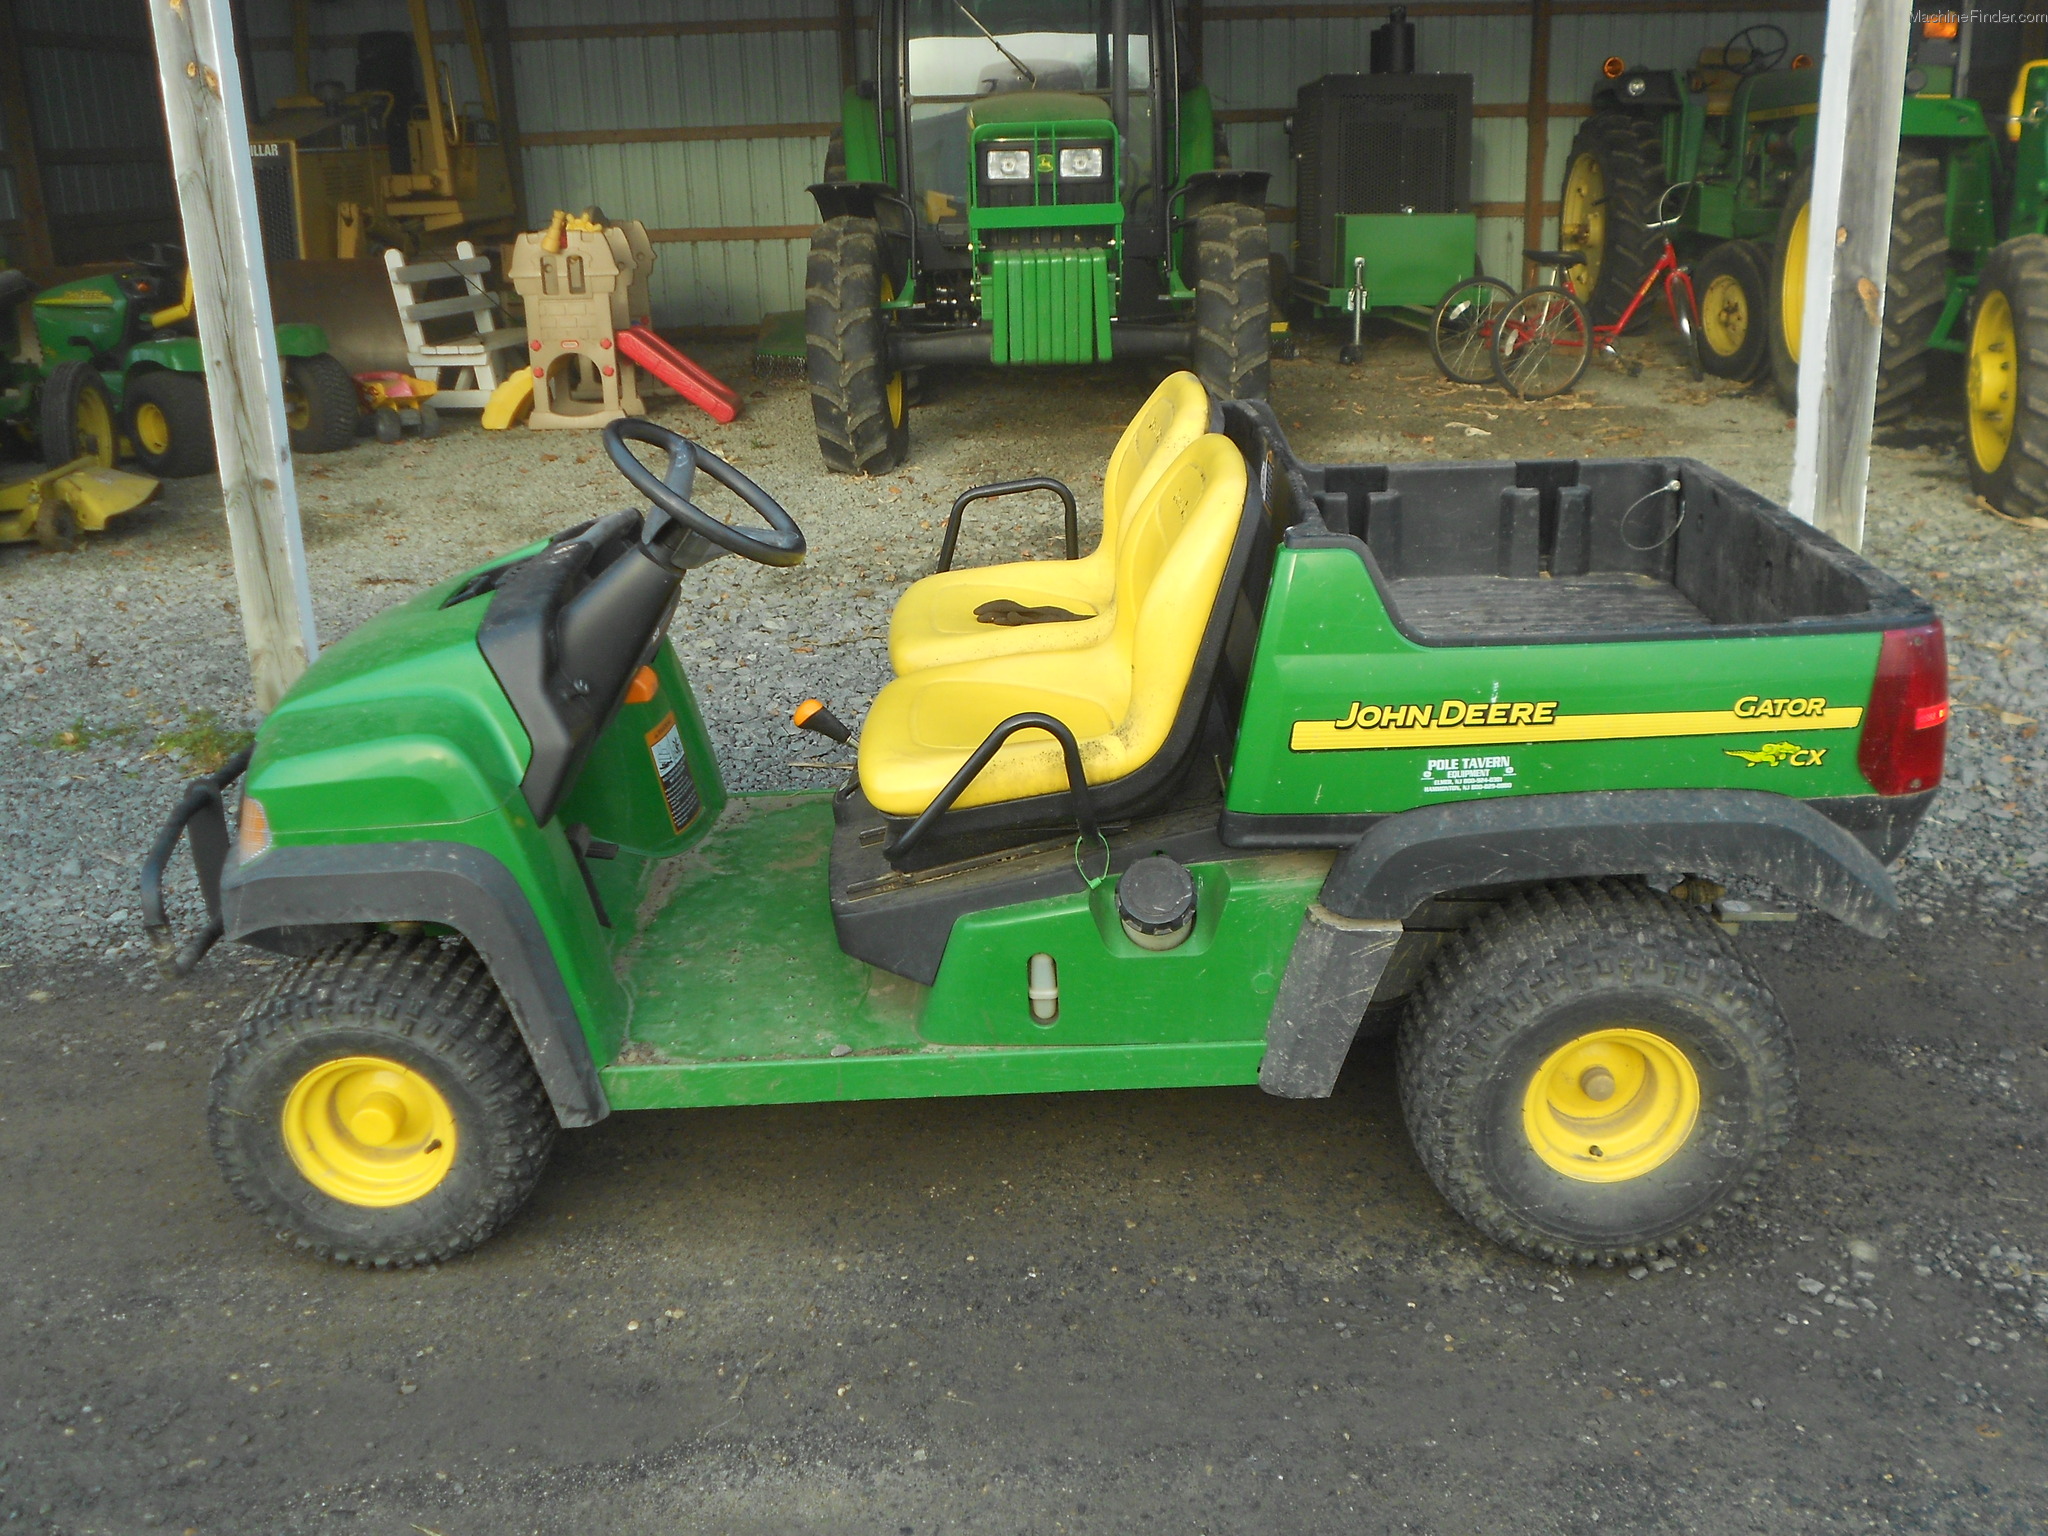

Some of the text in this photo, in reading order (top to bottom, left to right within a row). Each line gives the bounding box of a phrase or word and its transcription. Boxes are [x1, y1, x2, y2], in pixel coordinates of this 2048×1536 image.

[1335, 699, 1560, 729] JOHN DEERE
[1733, 696, 1828, 718] GATOR
[1427, 755, 1511, 771] POLE TAVERN
[1789, 749, 1828, 767] CX
[1447, 768, 1491, 779] EQUIPMENT
